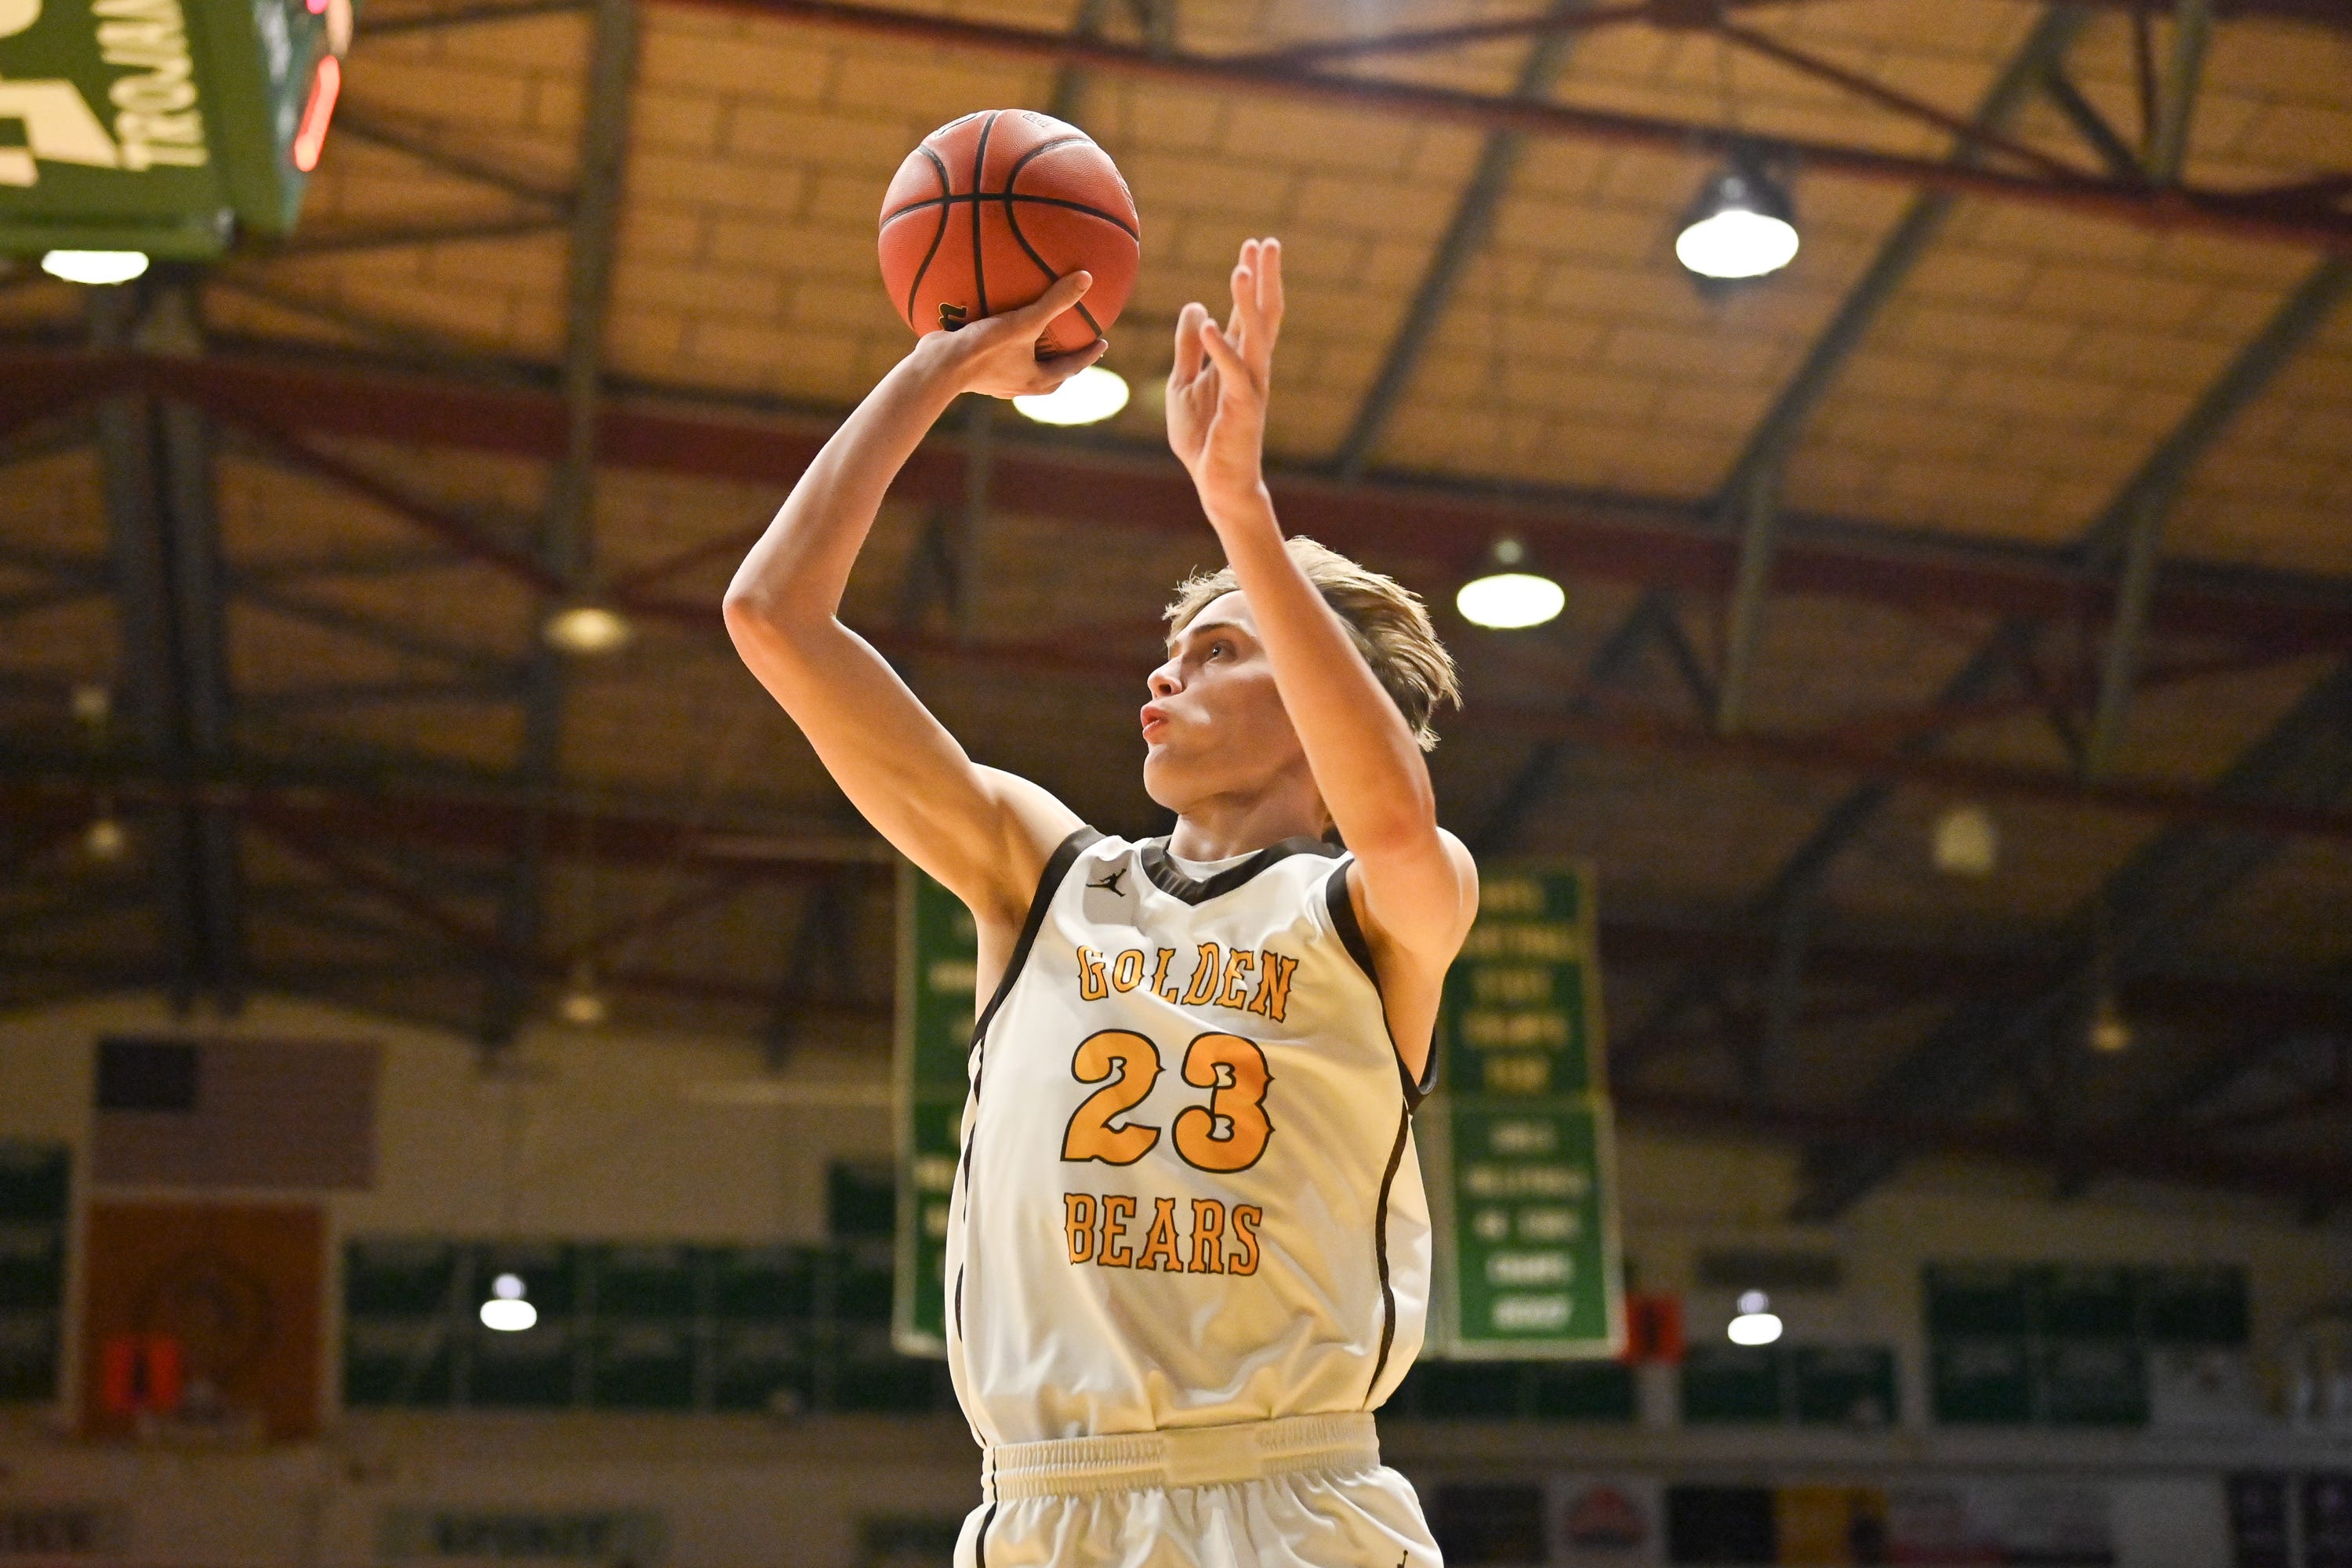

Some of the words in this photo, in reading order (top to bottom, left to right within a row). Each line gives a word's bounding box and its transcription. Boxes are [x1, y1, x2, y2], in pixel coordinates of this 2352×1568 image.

[1076, 942, 1298, 1022] GOLDEN
[1061, 1029, 1275, 1174] 23
[1064, 1193, 1262, 1276] BEARS
